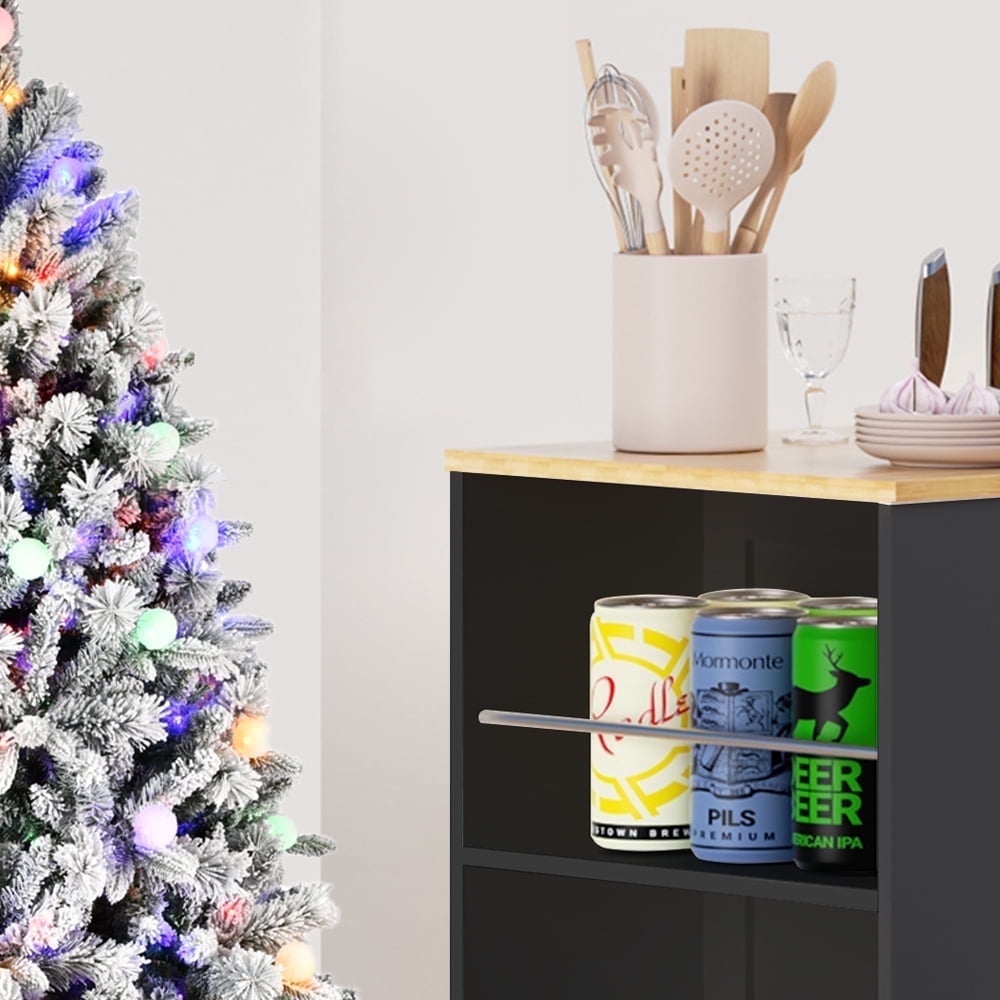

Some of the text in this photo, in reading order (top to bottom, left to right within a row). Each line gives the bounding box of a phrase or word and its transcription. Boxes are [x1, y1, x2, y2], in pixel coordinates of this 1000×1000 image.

[793, 756, 863, 793] EER
[708, 808, 756, 828] PILS
[793, 790, 863, 826] EER
[837, 836, 864, 849] IPA
